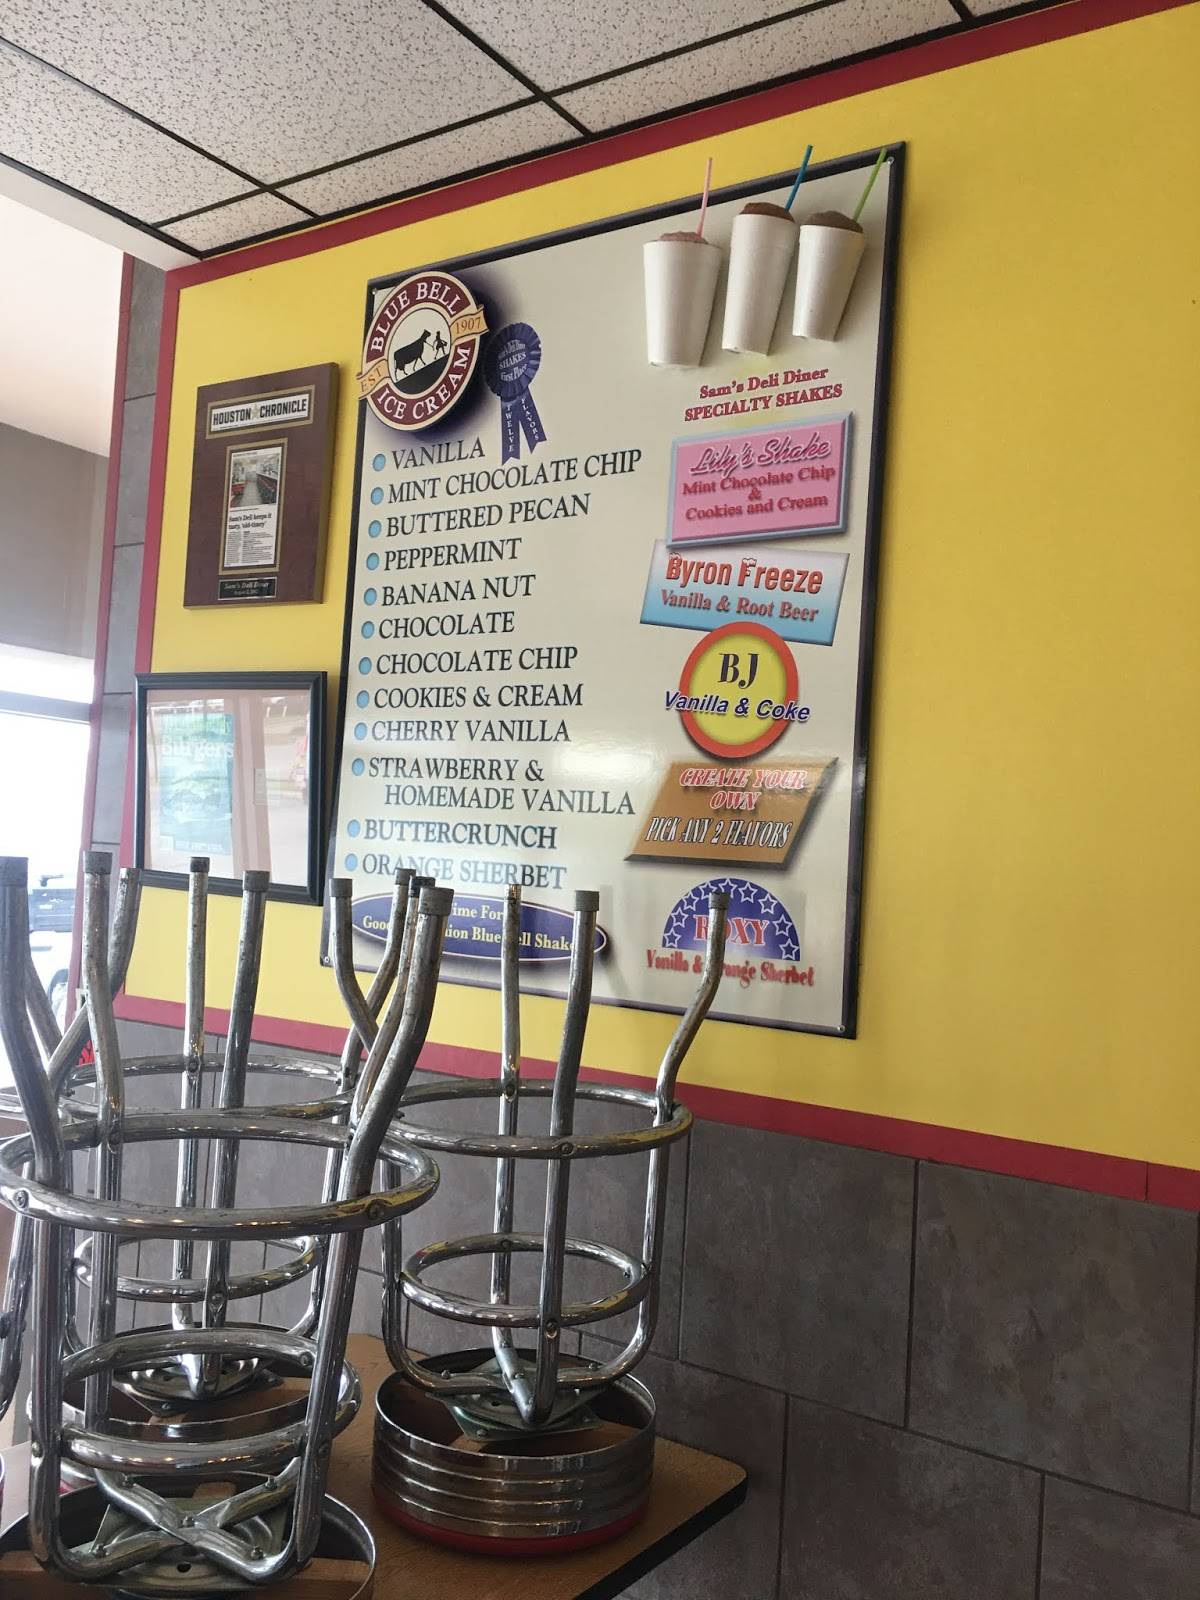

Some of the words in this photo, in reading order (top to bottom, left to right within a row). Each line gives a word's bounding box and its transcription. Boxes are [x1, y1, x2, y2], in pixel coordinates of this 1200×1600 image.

[371, 290, 411, 352] BLUE
[416, 281, 461, 316] BELL
[455, 315, 482, 335] 1907
[499, 352, 527, 370] SHAKES
[360, 367, 382, 393] EST
[376, 388, 407, 420] ICE
[412, 347, 471, 420] CREAM
[700, 380, 745, 399] Sam's
[747, 373, 780, 392] Deli
[782, 368, 829, 386] Diner
[213, 408, 251, 425] HOUSTON
[260, 399, 307, 418] CHRONICLE
[520, 396, 539, 441] FLAVORS
[685, 395, 773, 422] SPECIALTY
[775, 383, 843, 408] SHAKES
[505, 404, 515, 453] TWELVE
[392, 437, 485, 470] VANILLA
[690, 443, 755, 477] Lily's
[757, 431, 832, 466] Shake
[388, 477, 440, 504] MINT
[445, 457, 578, 497] CHOCOLATE
[584, 449, 642, 479] CHIP
[682, 480, 717, 496] Mint
[720, 471, 794, 491] Chocolate
[797, 465, 836, 482] Chip
[685, 503, 743, 521] Cookies
[746, 499, 773, 514] and
[777, 494, 829, 510] Cream
[748, 486, 763, 501] &
[386, 504, 503, 538] BUTTERED
[508, 492, 591, 523] PECAN
[384, 537, 522, 571] PEPPERMINT
[666, 552, 732, 588] Byron
[737, 558, 824, 594] Freeze
[381, 579, 476, 607] BANANA
[483, 574, 536, 599] NUT
[661, 589, 712, 610] Vanilla
[716, 595, 730, 612] &
[736, 597, 776, 617] Root
[779, 601, 819, 622] Beer
[378, 611, 515, 639] CHOCOLATE
[376, 649, 513, 675] CHOCOLATE
[518, 646, 578, 670] CHIP
[717, 652, 760, 689] BJ
[373, 686, 466, 709] COOKIES
[472, 686, 491, 708] &
[498, 683, 583, 707] CREAM
[665, 690, 729, 714] Vanilla
[734, 697, 749, 716] &
[756, 699, 811, 721] Coke
[371, 720, 459, 742] CHERRY
[464, 720, 571, 742] VANILLA
[368, 757, 518, 782] STRAWBERRY
[524, 759, 545, 782] &
[679, 768, 751, 788] CREATE
[753, 770, 808, 789] YOUR
[384, 784, 515, 811] HOMEMADE
[520, 788, 636, 816] VANILLA
[709, 791, 762, 810] OWN
[363, 818, 558, 850] BUTTERCRUNCH
[645, 816, 681, 842] PICK
[680, 818, 714, 844] ANY
[711, 820, 725, 844] 2
[723, 820, 793, 848] FLAVORS
[362, 853, 454, 880] ORANGE
[459, 859, 568, 890] SHERBET
[452, 903, 478, 918] ime
[481, 905, 504, 921] For
[472, 926, 502, 943] Blue
[646, 948, 689, 972] Vanilla
[692, 954, 703, 974] &
[722, 960, 757, 989] ange
[760, 961, 815, 987] Sherbet
